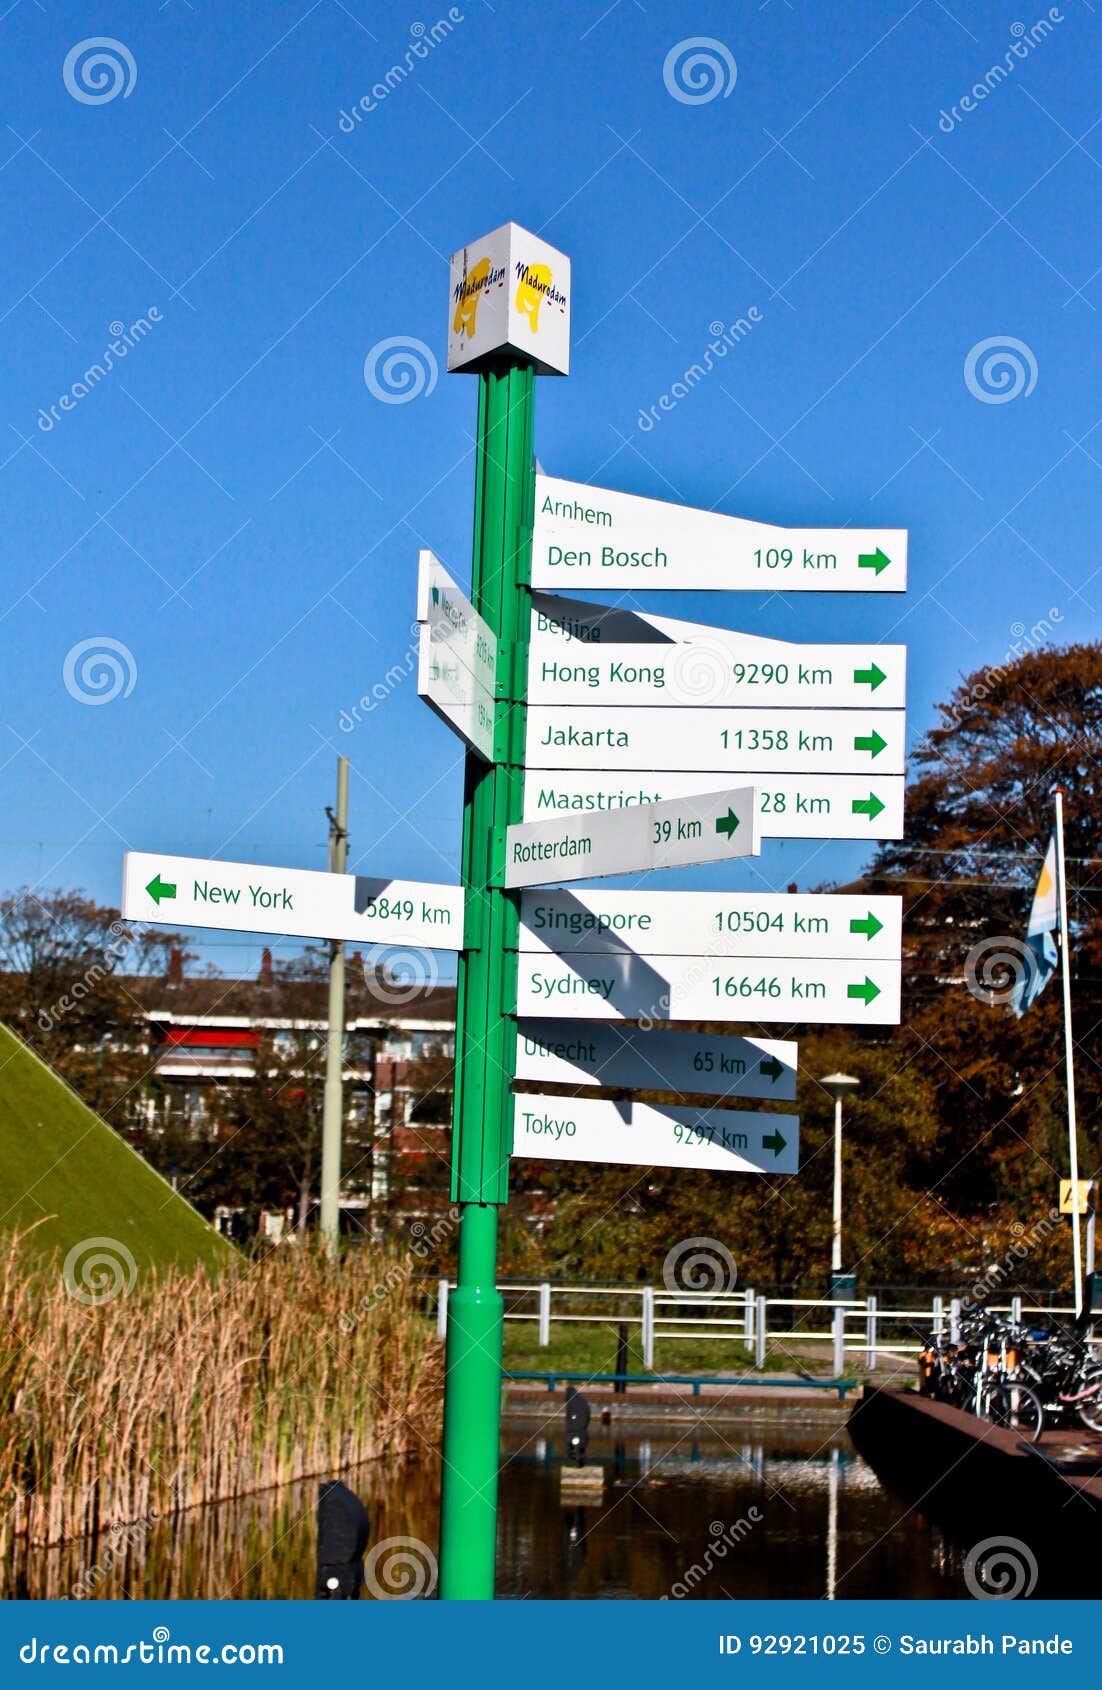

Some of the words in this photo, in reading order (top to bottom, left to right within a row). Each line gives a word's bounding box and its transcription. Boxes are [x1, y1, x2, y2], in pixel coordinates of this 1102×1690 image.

[454, 266, 506, 303] Madurodam
[515, 261, 566, 306] Madurodam
[541, 495, 613, 527] Arnhem
[547, 546, 591, 567] Den
[601, 546, 668, 568] Bosch
[752, 548, 793, 569] 109
[802, 548, 837, 569] km
[537, 611, 601, 643] Beijing
[541, 661, 600, 688] Hong
[609, 662, 665, 688] Kong
[732, 663, 789, 685] 9290
[798, 664, 833, 685] km
[540, 725, 629, 748] Jakarta
[719, 729, 789, 751] 11358
[798, 730, 833, 752] km
[796, 792, 831, 814] km
[513, 835, 592, 863] Rotterdam
[653, 821, 672, 843] 39
[677, 817, 702, 840] km
[193, 880, 240, 904] New
[248, 885, 294, 910] York
[366, 898, 414, 921] 5849
[421, 902, 451, 925] km
[533, 907, 652, 934] Singapore
[714, 911, 784, 932] 10504
[794, 911, 829, 933] km
[530, 973, 616, 1000] Sydney
[712, 976, 782, 998] 16646
[791, 977, 826, 998] km
[524, 1035, 597, 1062] Utrecht
[693, 1051, 714, 1072] 65
[720, 1052, 746, 1074] km
[522, 1112, 577, 1138] Tokyo
[673, 1124, 716, 1146] 9297
[722, 1127, 748, 1149] km
